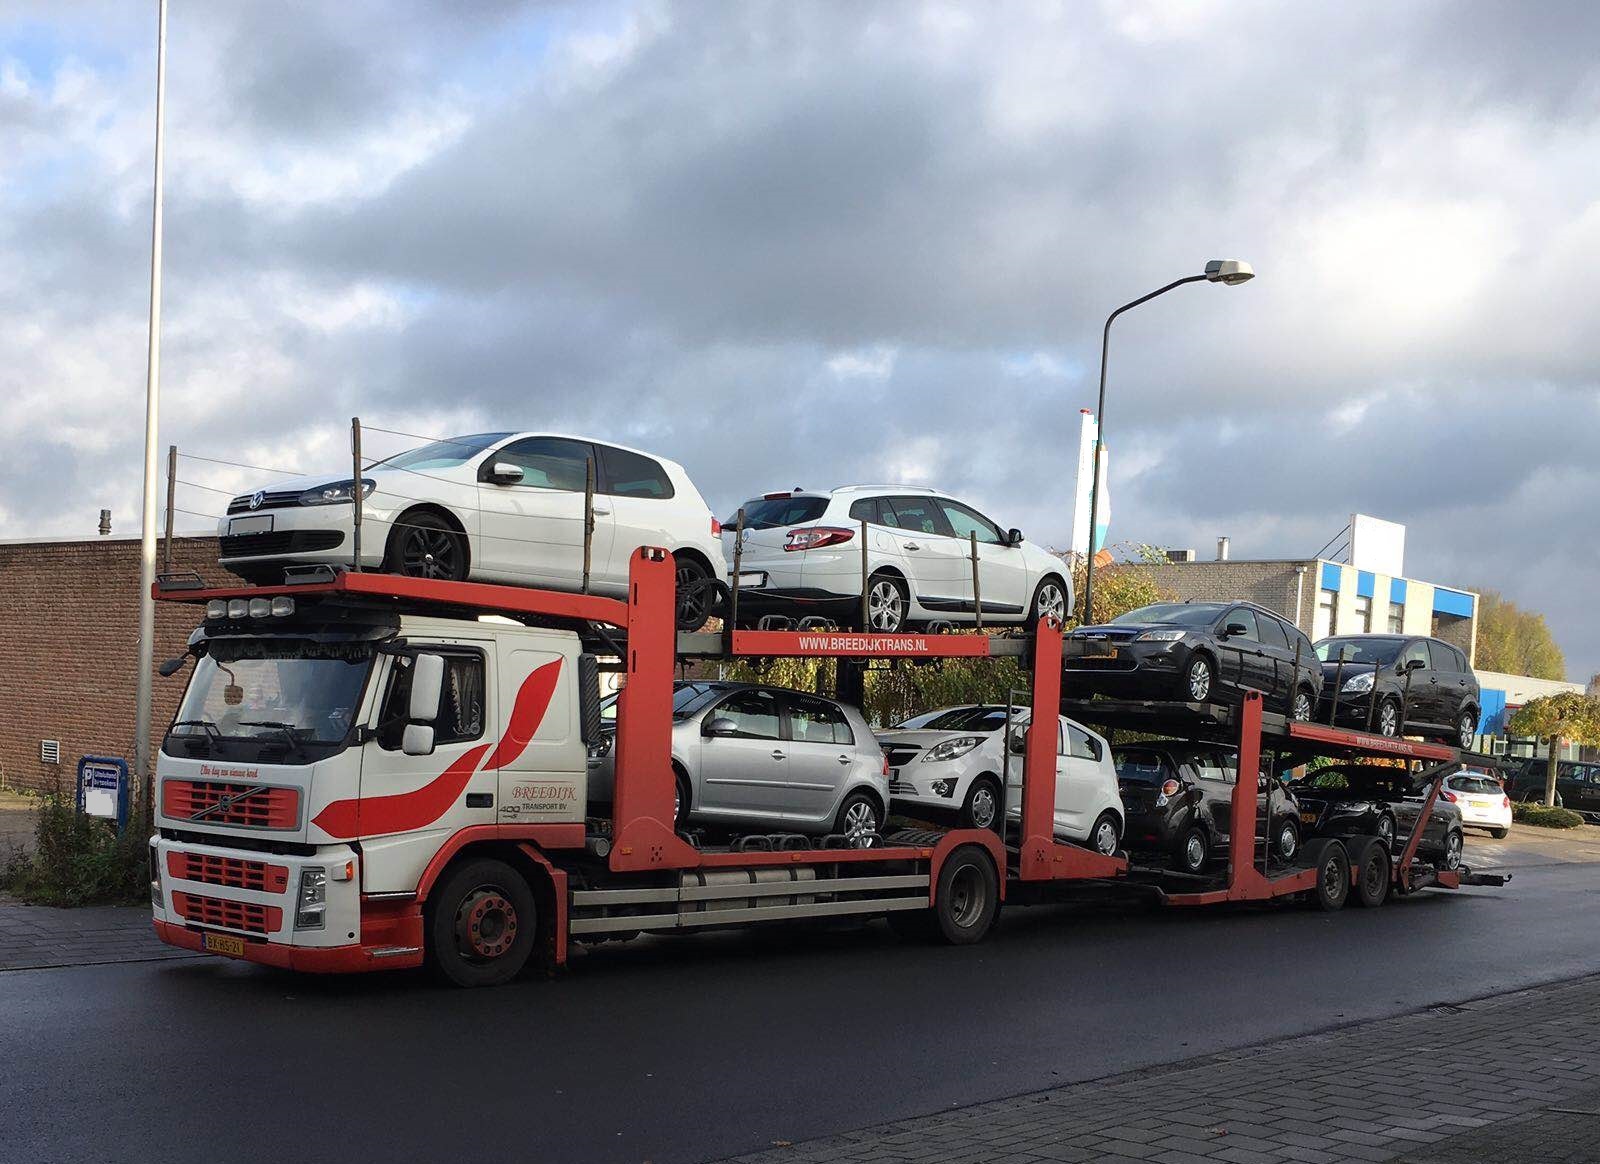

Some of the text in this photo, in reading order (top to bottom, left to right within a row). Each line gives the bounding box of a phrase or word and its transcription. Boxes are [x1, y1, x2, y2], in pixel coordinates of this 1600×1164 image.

[798, 636, 928, 651] WWW.BREEDIJKTRANS.NL
[211, 765, 220, 778] dag
[512, 786, 577, 801] BREEDIJK
[499, 805, 520, 813] 400
